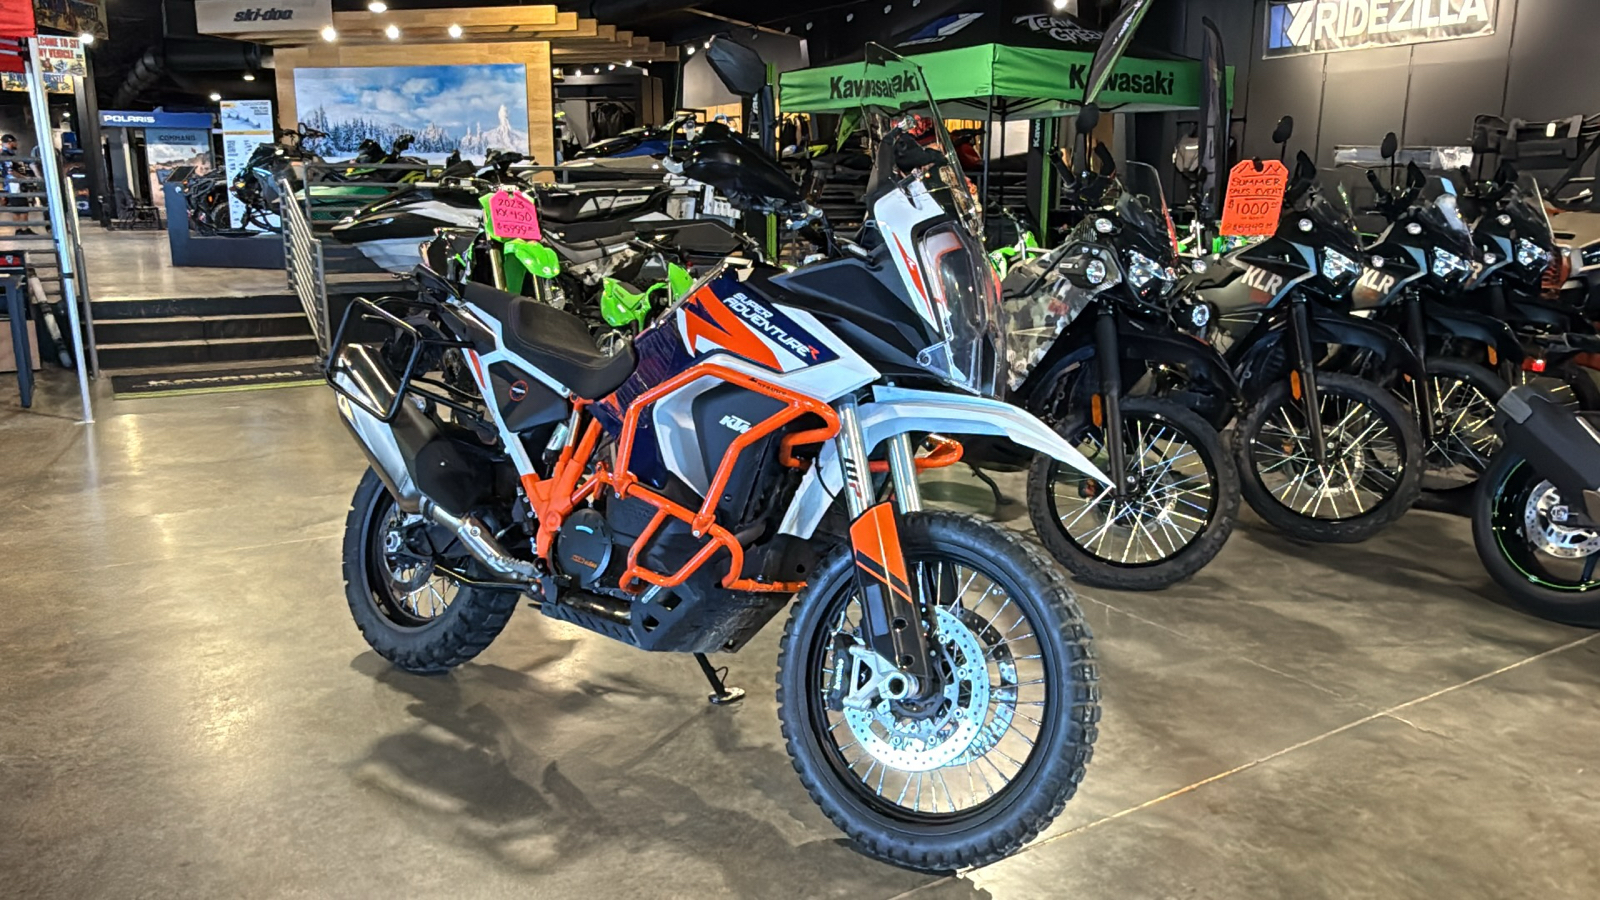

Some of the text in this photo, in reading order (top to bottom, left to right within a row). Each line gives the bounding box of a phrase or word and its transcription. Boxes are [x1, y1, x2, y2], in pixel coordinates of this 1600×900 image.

[233, 7, 293, 22] ski-doo
[1012, 13, 1082, 31] TEAM
[1314, 0, 1489, 40] RIDEZILLA
[1069, 63, 1174, 95] Kwasaki
[103, 114, 155, 124] POLARIS
[1230, 177, 1283, 188] SUMMER
[1254, 187, 1283, 195] EVENT
[498, 199, 525, 210] 2023
[1241, 265, 1283, 296] KLR
[732, 292, 774, 319] SUPER
[723, 297, 810, 357] ADVENTURE
